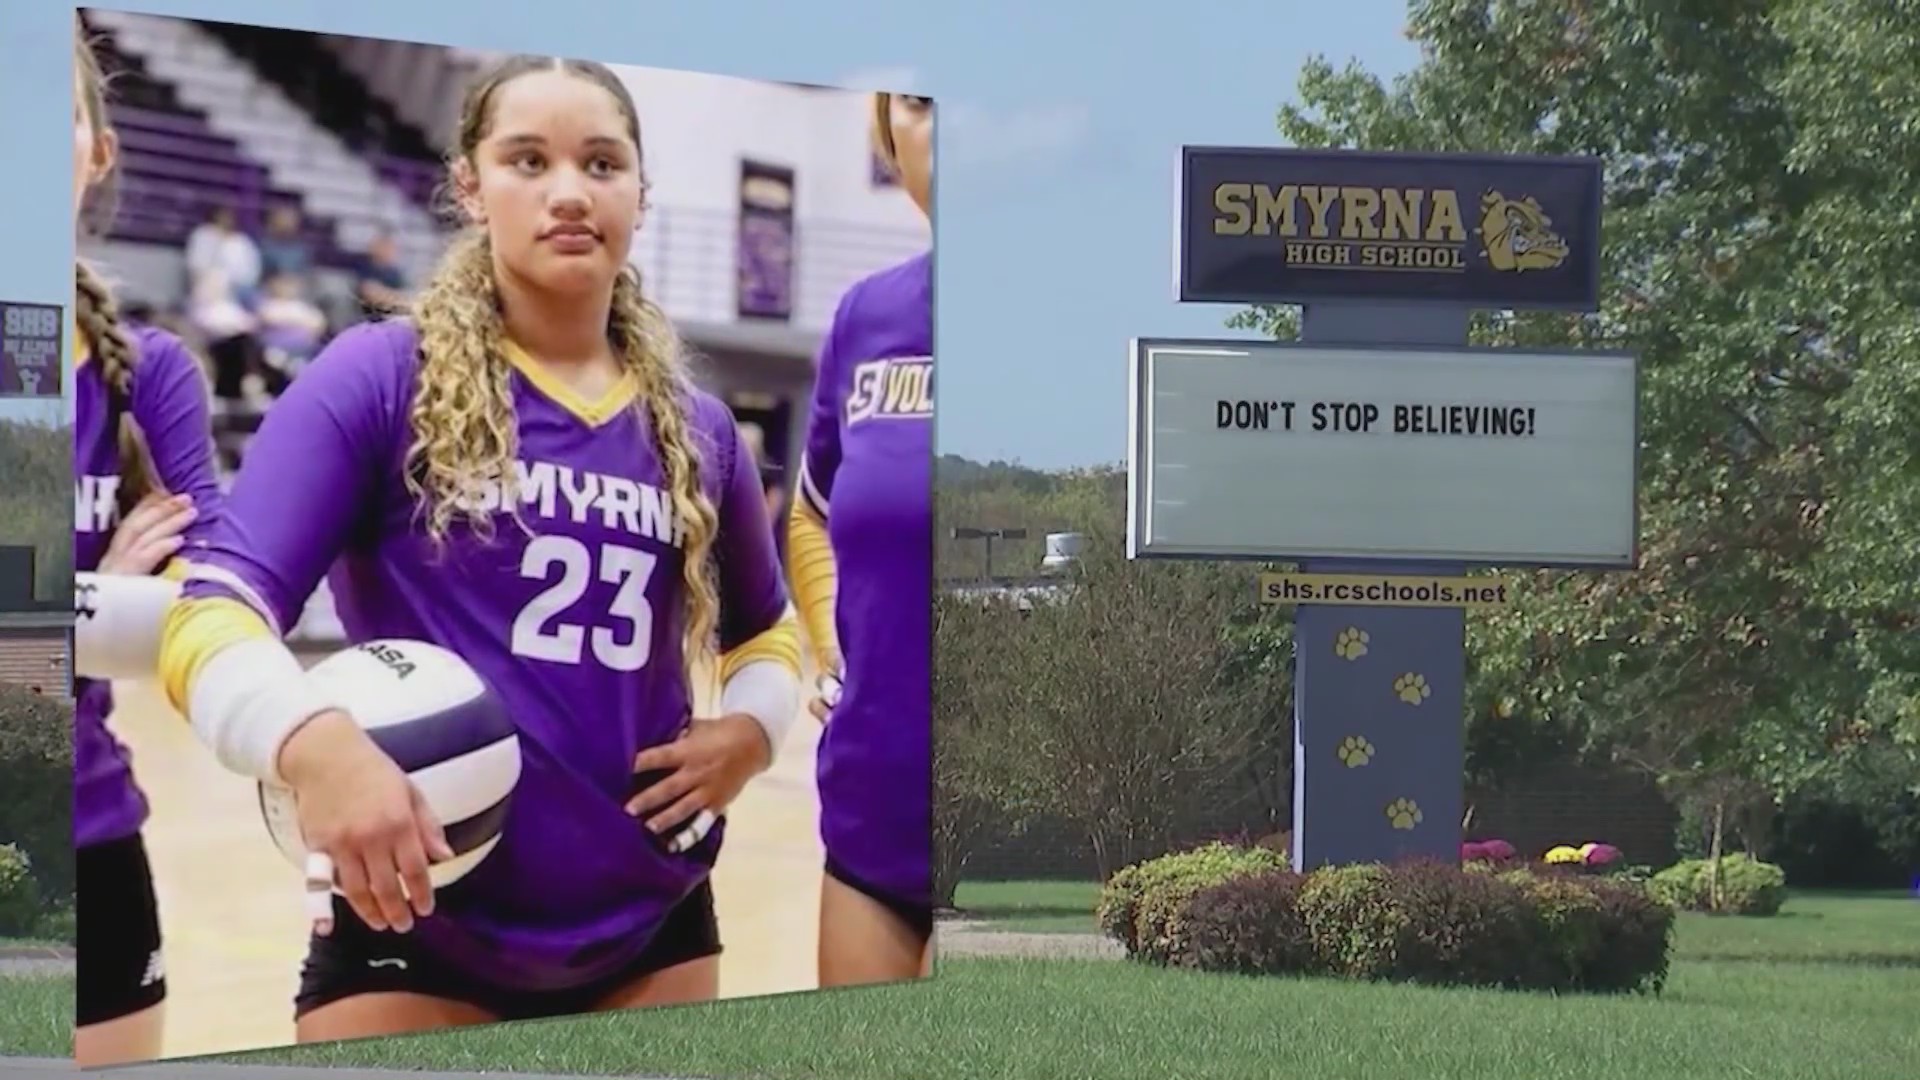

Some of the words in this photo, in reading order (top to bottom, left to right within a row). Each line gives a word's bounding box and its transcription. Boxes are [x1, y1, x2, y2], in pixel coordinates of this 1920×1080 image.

[1214, 183, 1467, 241] SMYRNA
[1286, 244, 1351, 266] HIGH
[1361, 245, 1466, 269] SCHOOL
[1217, 400, 1296, 430] DON'T
[1311, 402, 1379, 433] STOP
[1393, 404, 1536, 435] BELIEVING!
[511, 534, 658, 672] 23
[1267, 578, 1507, 604] shs.rcschools.net
